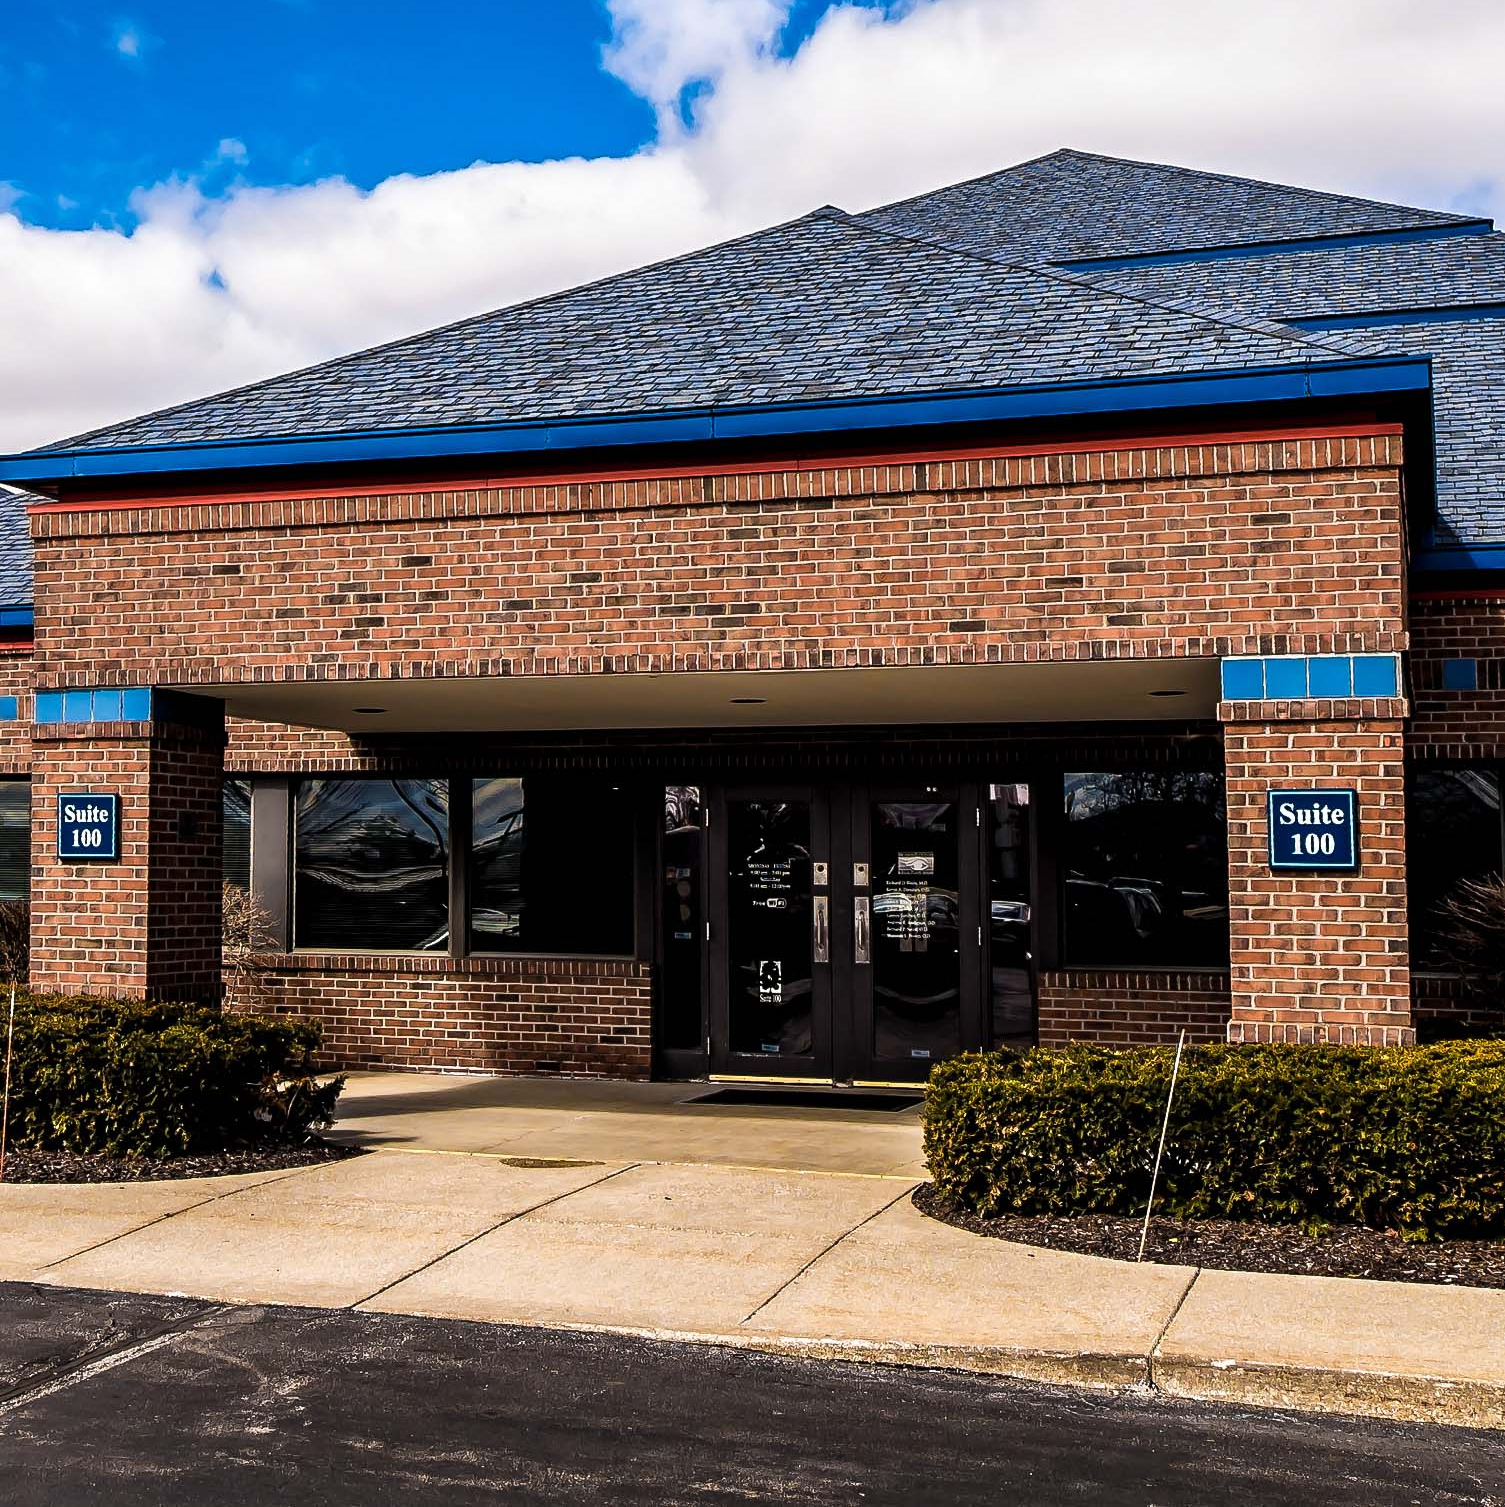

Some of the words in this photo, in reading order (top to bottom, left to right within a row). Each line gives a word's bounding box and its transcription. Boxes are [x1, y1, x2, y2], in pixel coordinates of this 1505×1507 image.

[64, 804, 109, 823] Suite
[1279, 802, 1344, 825] Suite
[71, 828, 102, 847] 100
[1290, 833, 1335, 855] 100
